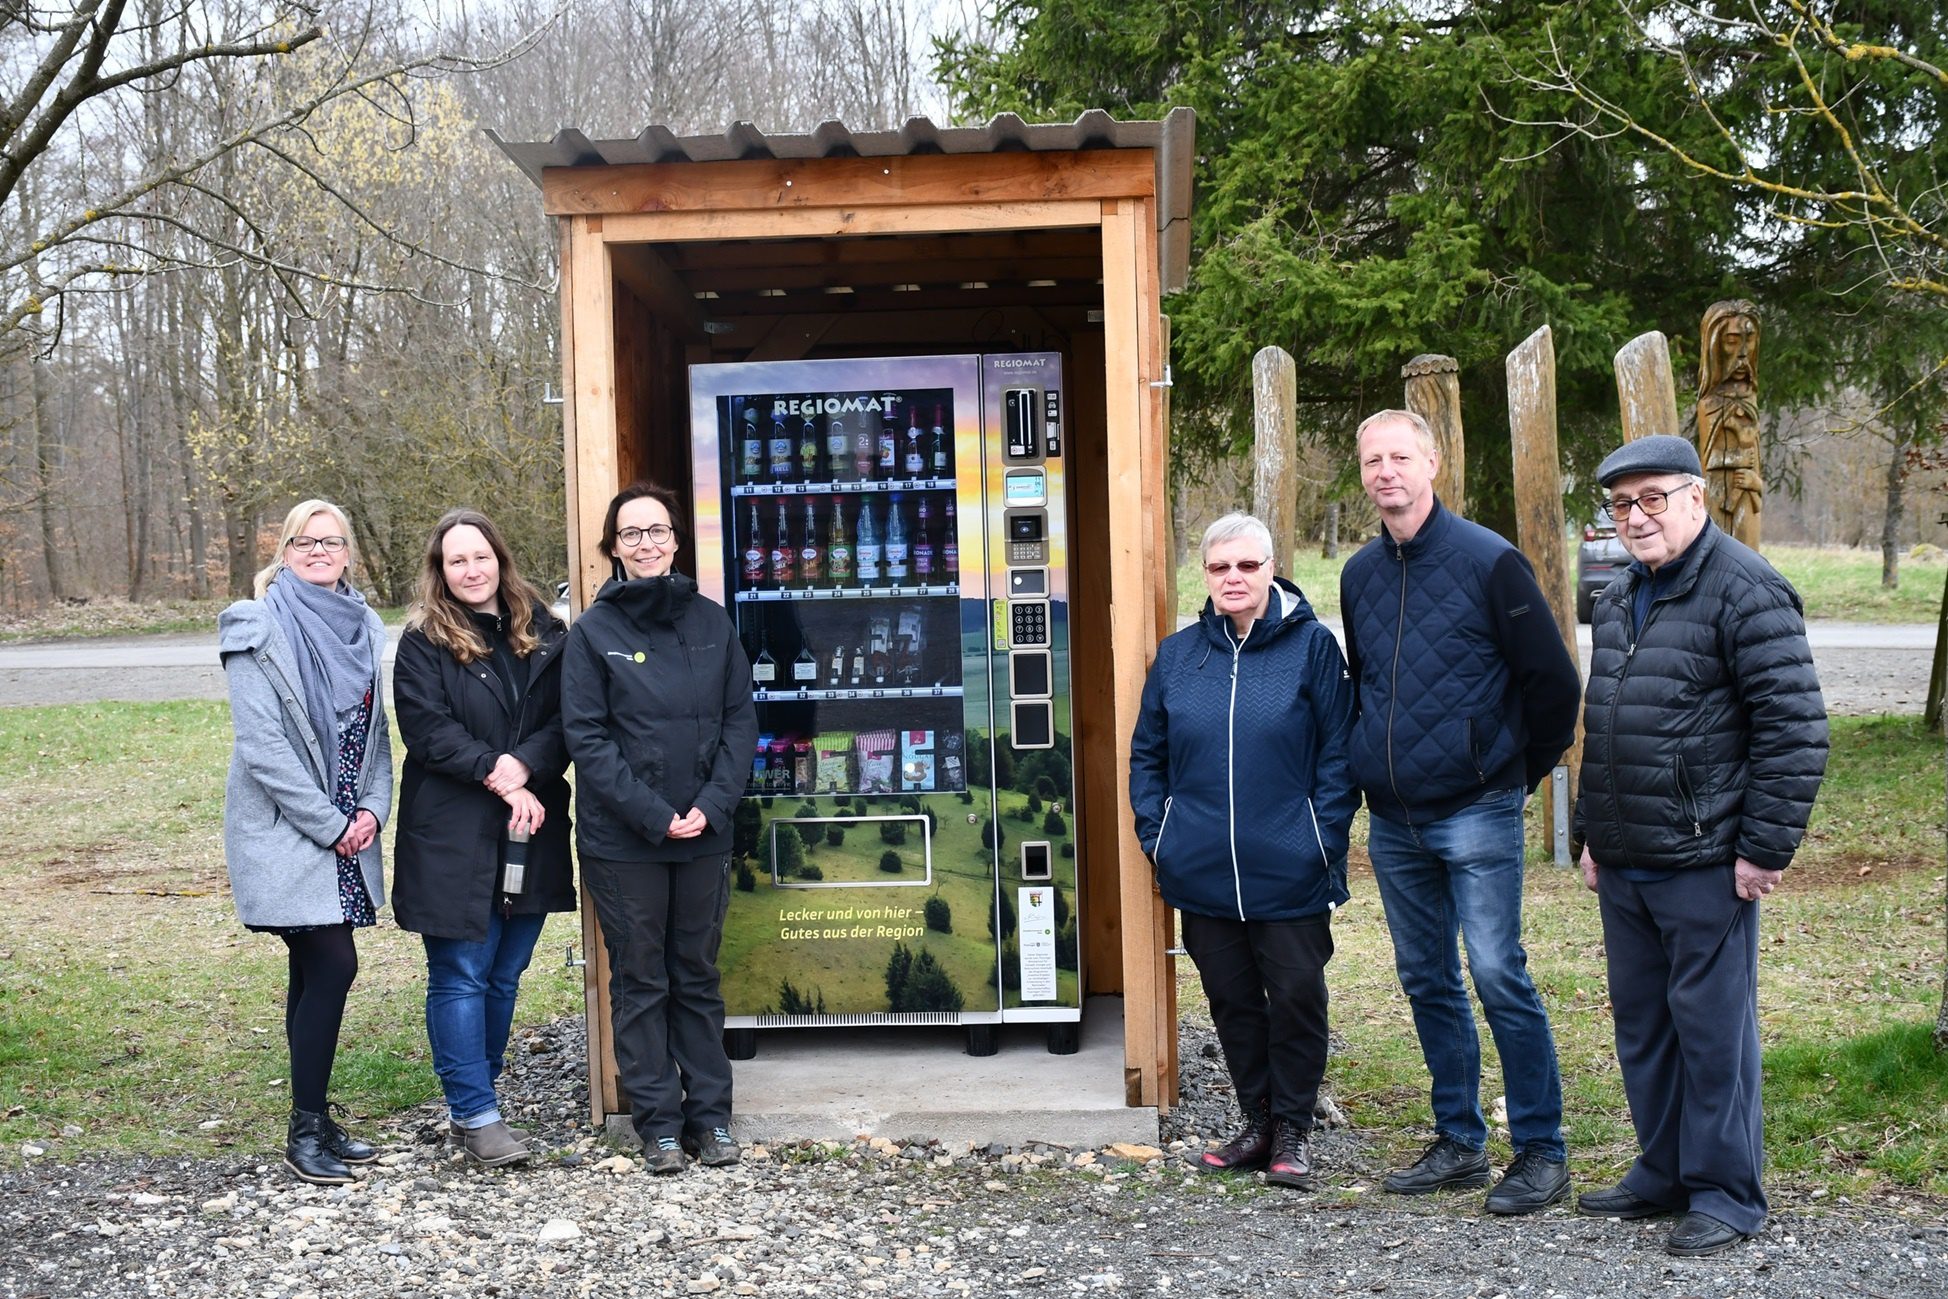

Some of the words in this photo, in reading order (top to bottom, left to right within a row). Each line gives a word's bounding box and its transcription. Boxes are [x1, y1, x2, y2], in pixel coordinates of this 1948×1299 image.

[994, 358, 1046, 368] REGIOMAT
[774, 396, 896, 416] REGIOMAT
[779, 907, 824, 921] Lecker
[826, 906, 853, 920] und
[856, 909, 881, 919] von
[884, 906, 912, 919] hier
[780, 927, 820, 940] Gutes
[822, 928, 847, 939] aus
[850, 925, 873, 938] der
[876, 924, 924, 940] Region
